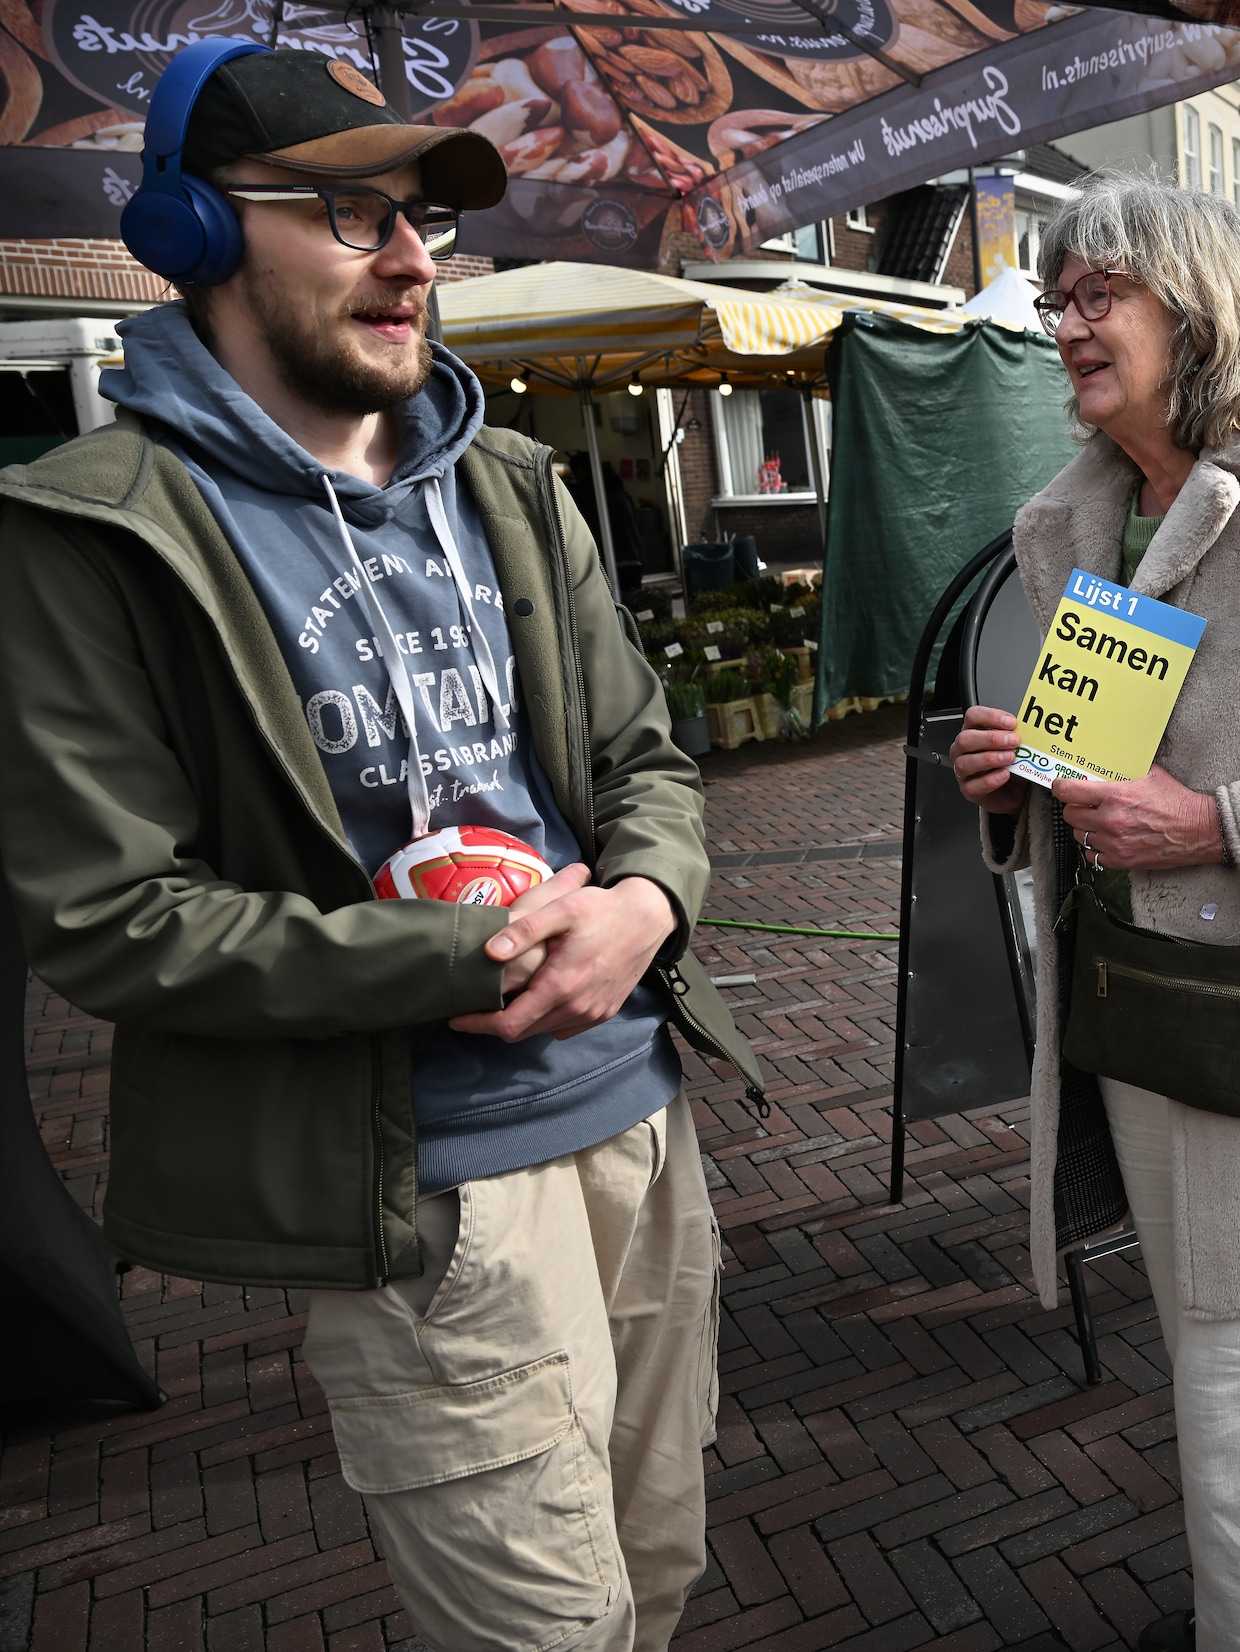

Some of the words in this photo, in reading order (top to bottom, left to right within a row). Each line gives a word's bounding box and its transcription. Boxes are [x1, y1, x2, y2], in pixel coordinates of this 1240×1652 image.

[1072, 575, 1123, 611] Lijst
[1127, 597, 1139, 617] 1
[1056, 612, 1170, 681] Samen
[1038, 652, 1100, 702] kan
[1021, 695, 1079, 743] het
[1049, 744, 1074, 761] Stem
[1075, 755, 1086, 766] 18
[1086, 762, 1114, 779] maart
[1054, 763, 1082, 780] GROEN
